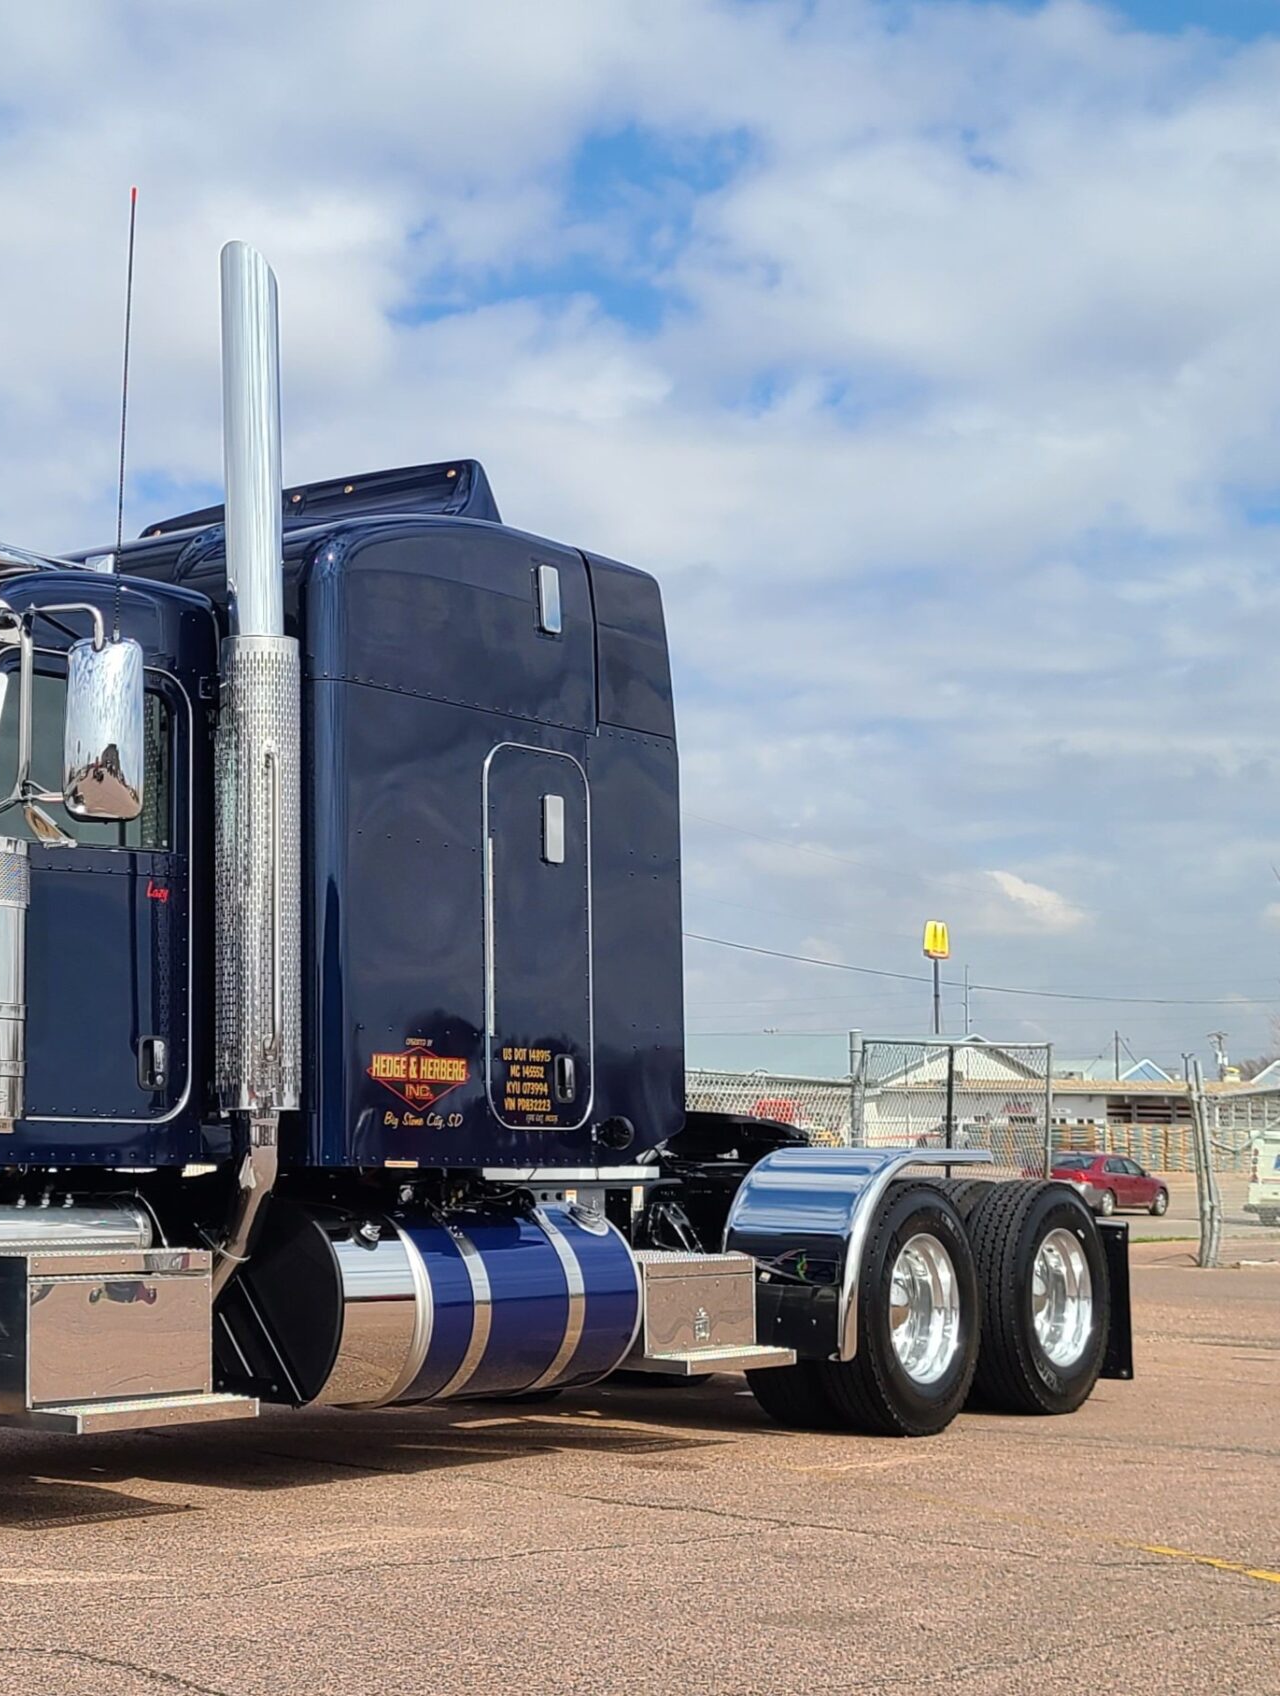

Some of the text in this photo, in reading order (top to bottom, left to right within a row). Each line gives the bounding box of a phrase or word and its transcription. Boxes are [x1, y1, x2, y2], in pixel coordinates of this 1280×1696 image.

[502, 1047, 512, 1061] US
[514, 1048, 527, 1061] DOT
[372, 1054, 466, 1081] HEDGE & HERBERG
[510, 1064, 521, 1077] MC
[405, 1084, 434, 1099] INC.
[506, 1081, 521, 1094] KYU
[504, 1097, 516, 1111] VIN
[384, 1111, 399, 1129] Big
[402, 1112, 424, 1126] Stone
[447, 1113, 464, 1127] SD
